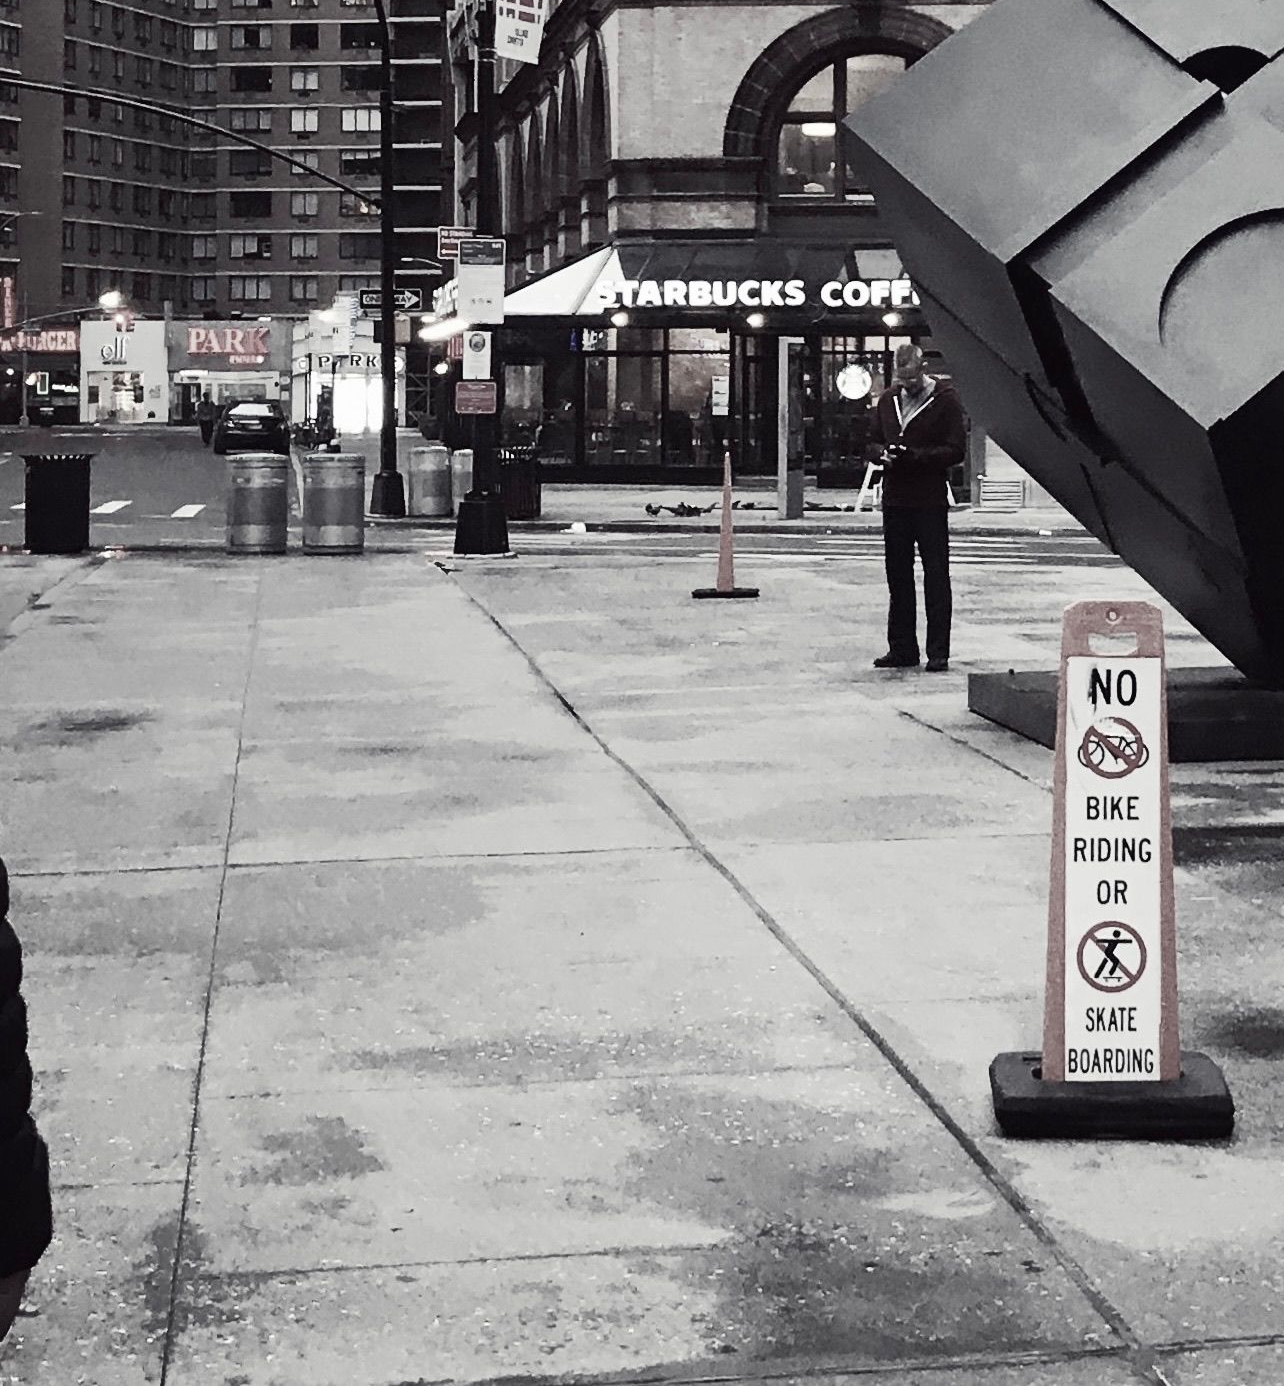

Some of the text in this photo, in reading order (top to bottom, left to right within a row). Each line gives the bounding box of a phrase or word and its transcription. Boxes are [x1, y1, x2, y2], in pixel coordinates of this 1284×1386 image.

[597, 279, 920, 307] STARBUCKS COFF
[187, 327, 270, 354] PARK
[1089, 667, 1137, 706] NO
[1086, 796, 1139, 820] BIKE
[1073, 837, 1152, 863] RIDING
[1096, 880, 1128, 905] OR
[1085, 1007, 1138, 1032] SKATE
[1068, 1048, 1154, 1074] BOARDING
